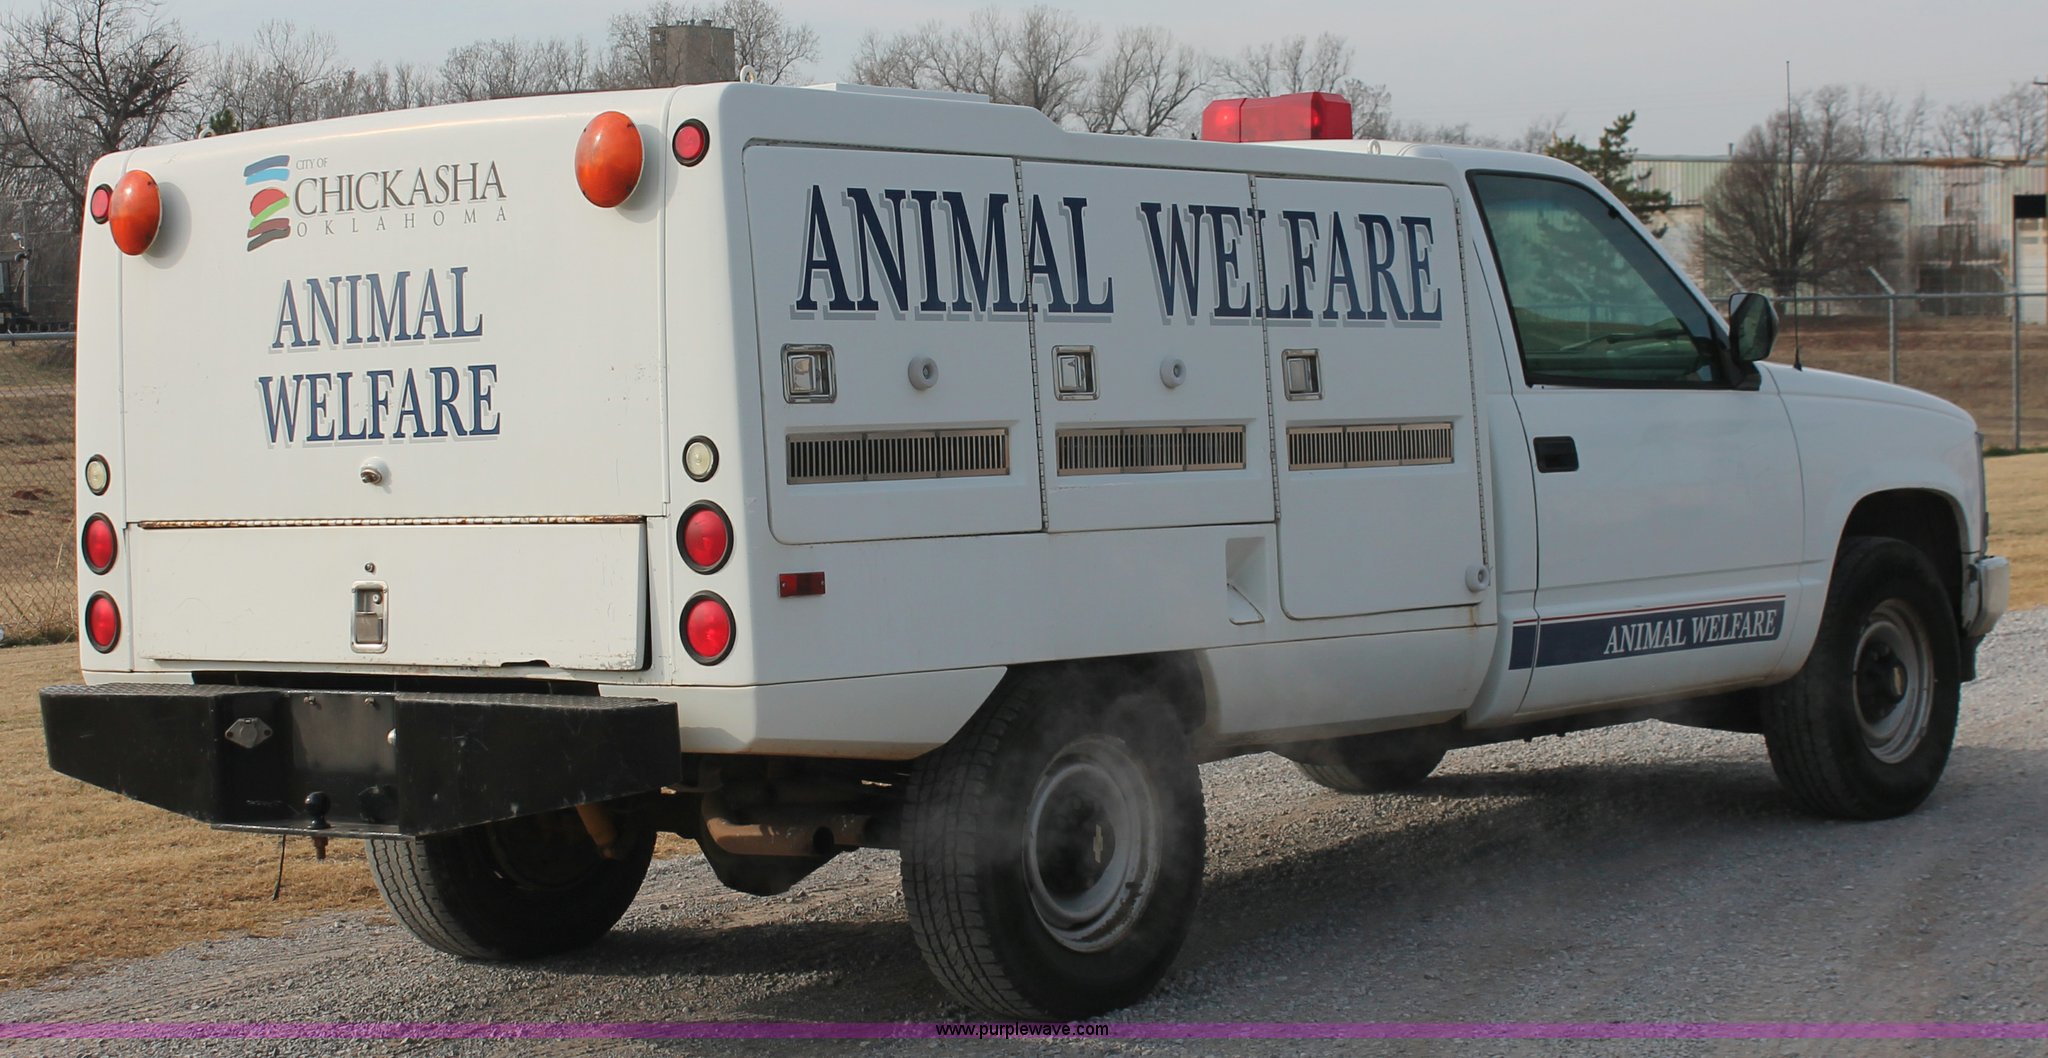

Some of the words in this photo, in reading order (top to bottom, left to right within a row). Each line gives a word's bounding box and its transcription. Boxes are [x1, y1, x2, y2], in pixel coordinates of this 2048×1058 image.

[294, 160, 507, 216] CHICKASHA
[296, 158, 314, 170] CITY
[316, 157, 328, 168] OF
[794, 184, 1114, 317] ANIMAL
[1137, 201, 1443, 323] WELFARE
[270, 266, 484, 350] ANIMAL
[258, 364, 501, 445] WELFARE
[1603, 618, 1687, 655] ANIMAL
[1692, 608, 1777, 643] WELFARE
